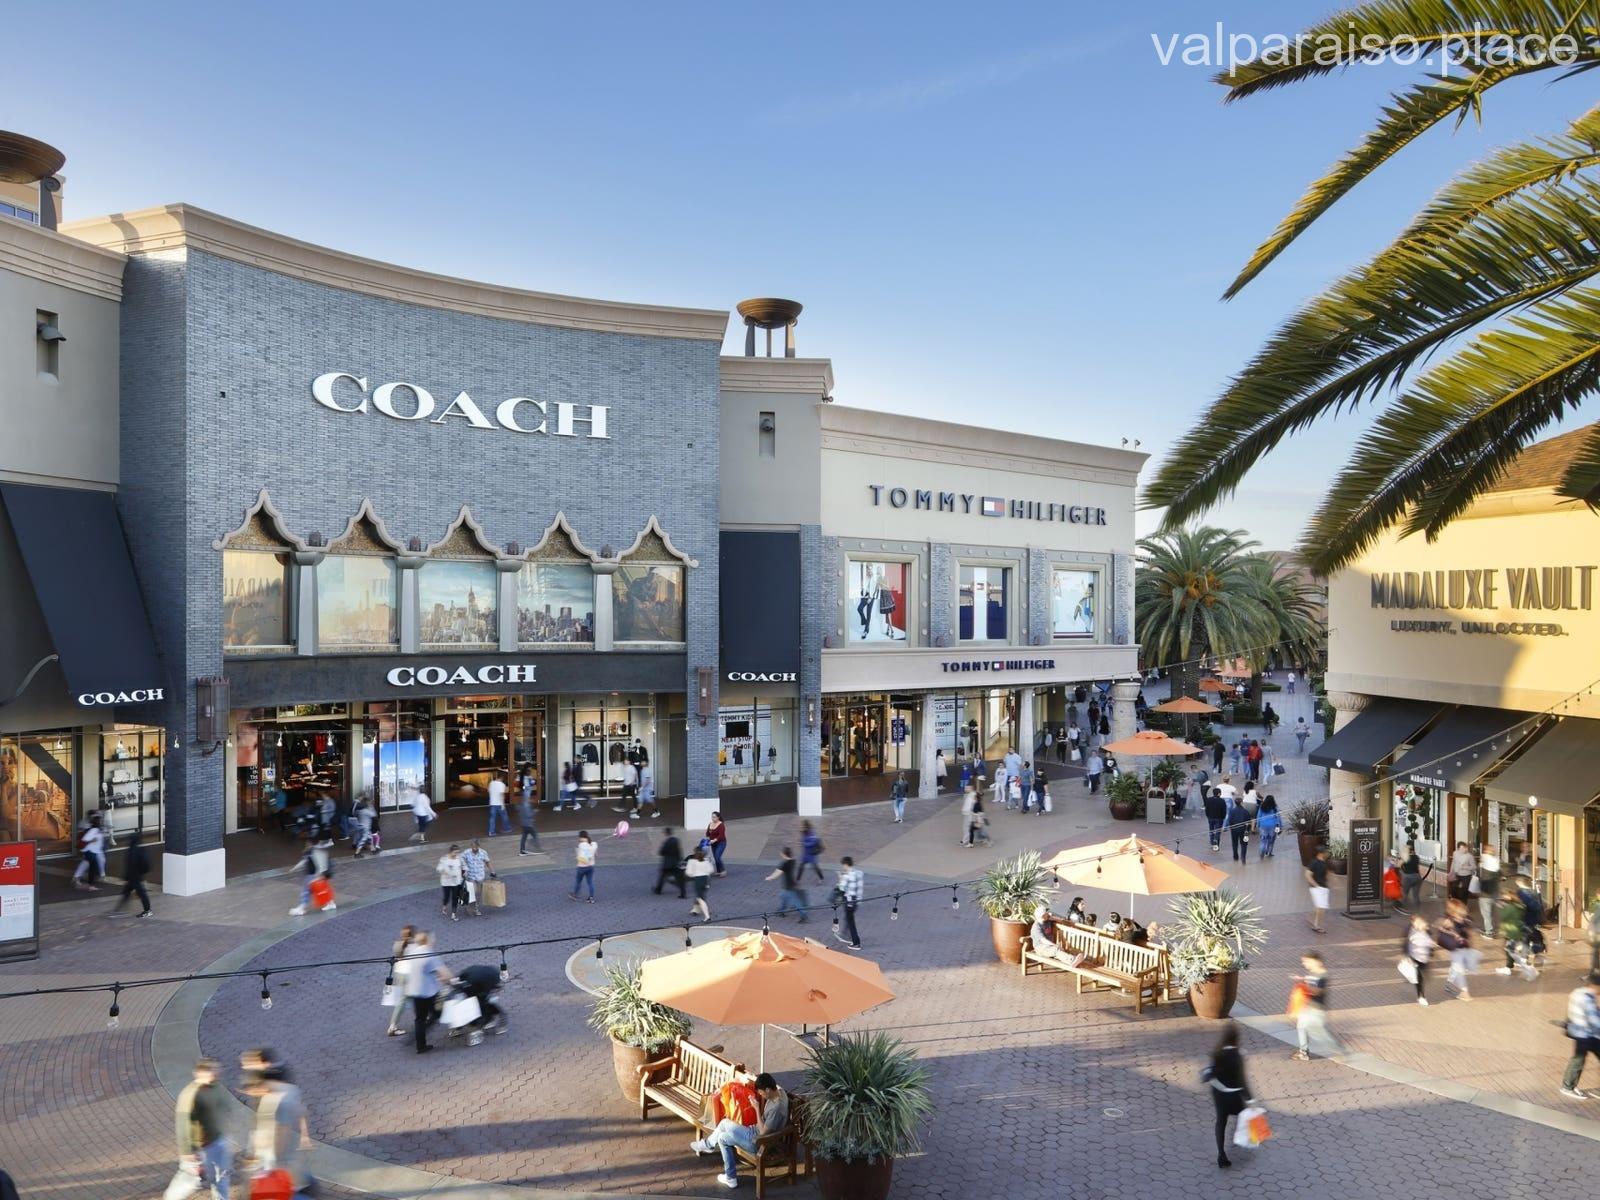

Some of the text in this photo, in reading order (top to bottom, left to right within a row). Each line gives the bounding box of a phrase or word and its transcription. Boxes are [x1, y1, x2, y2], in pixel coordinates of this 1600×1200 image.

[312, 372, 611, 439] COACH
[869, 484, 1107, 526] TOMMY HILFIGER
[1371, 565, 1598, 611] MADALUXE VAULT
[387, 664, 537, 686] COACH
[941, 659, 1055, 672] TOMMY HILFIGER
[728, 672, 797, 682] COACH
[78, 688, 164, 706] COACH
